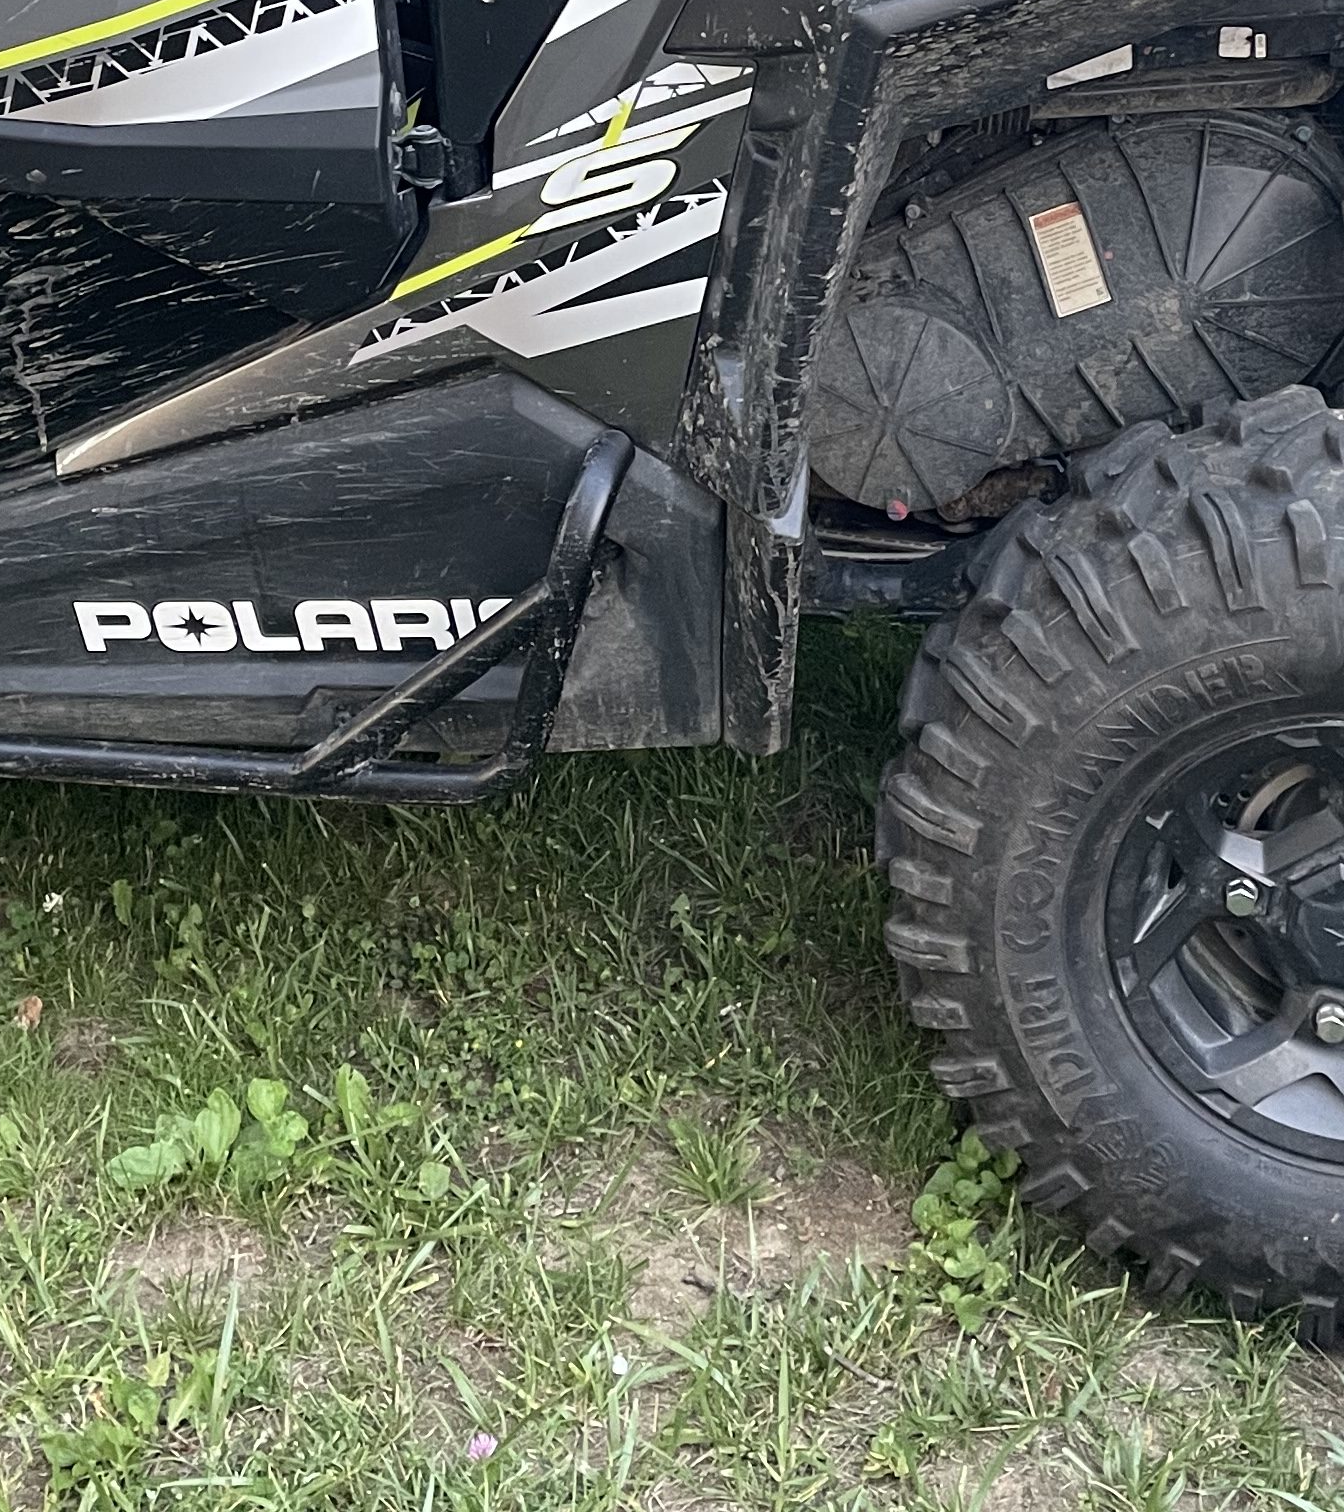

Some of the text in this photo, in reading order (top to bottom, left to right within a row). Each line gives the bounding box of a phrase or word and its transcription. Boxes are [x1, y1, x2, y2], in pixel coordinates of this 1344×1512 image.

[519, 124, 702, 239] S
[1001, 653, 1275, 1095] DIRT COMMANDER
